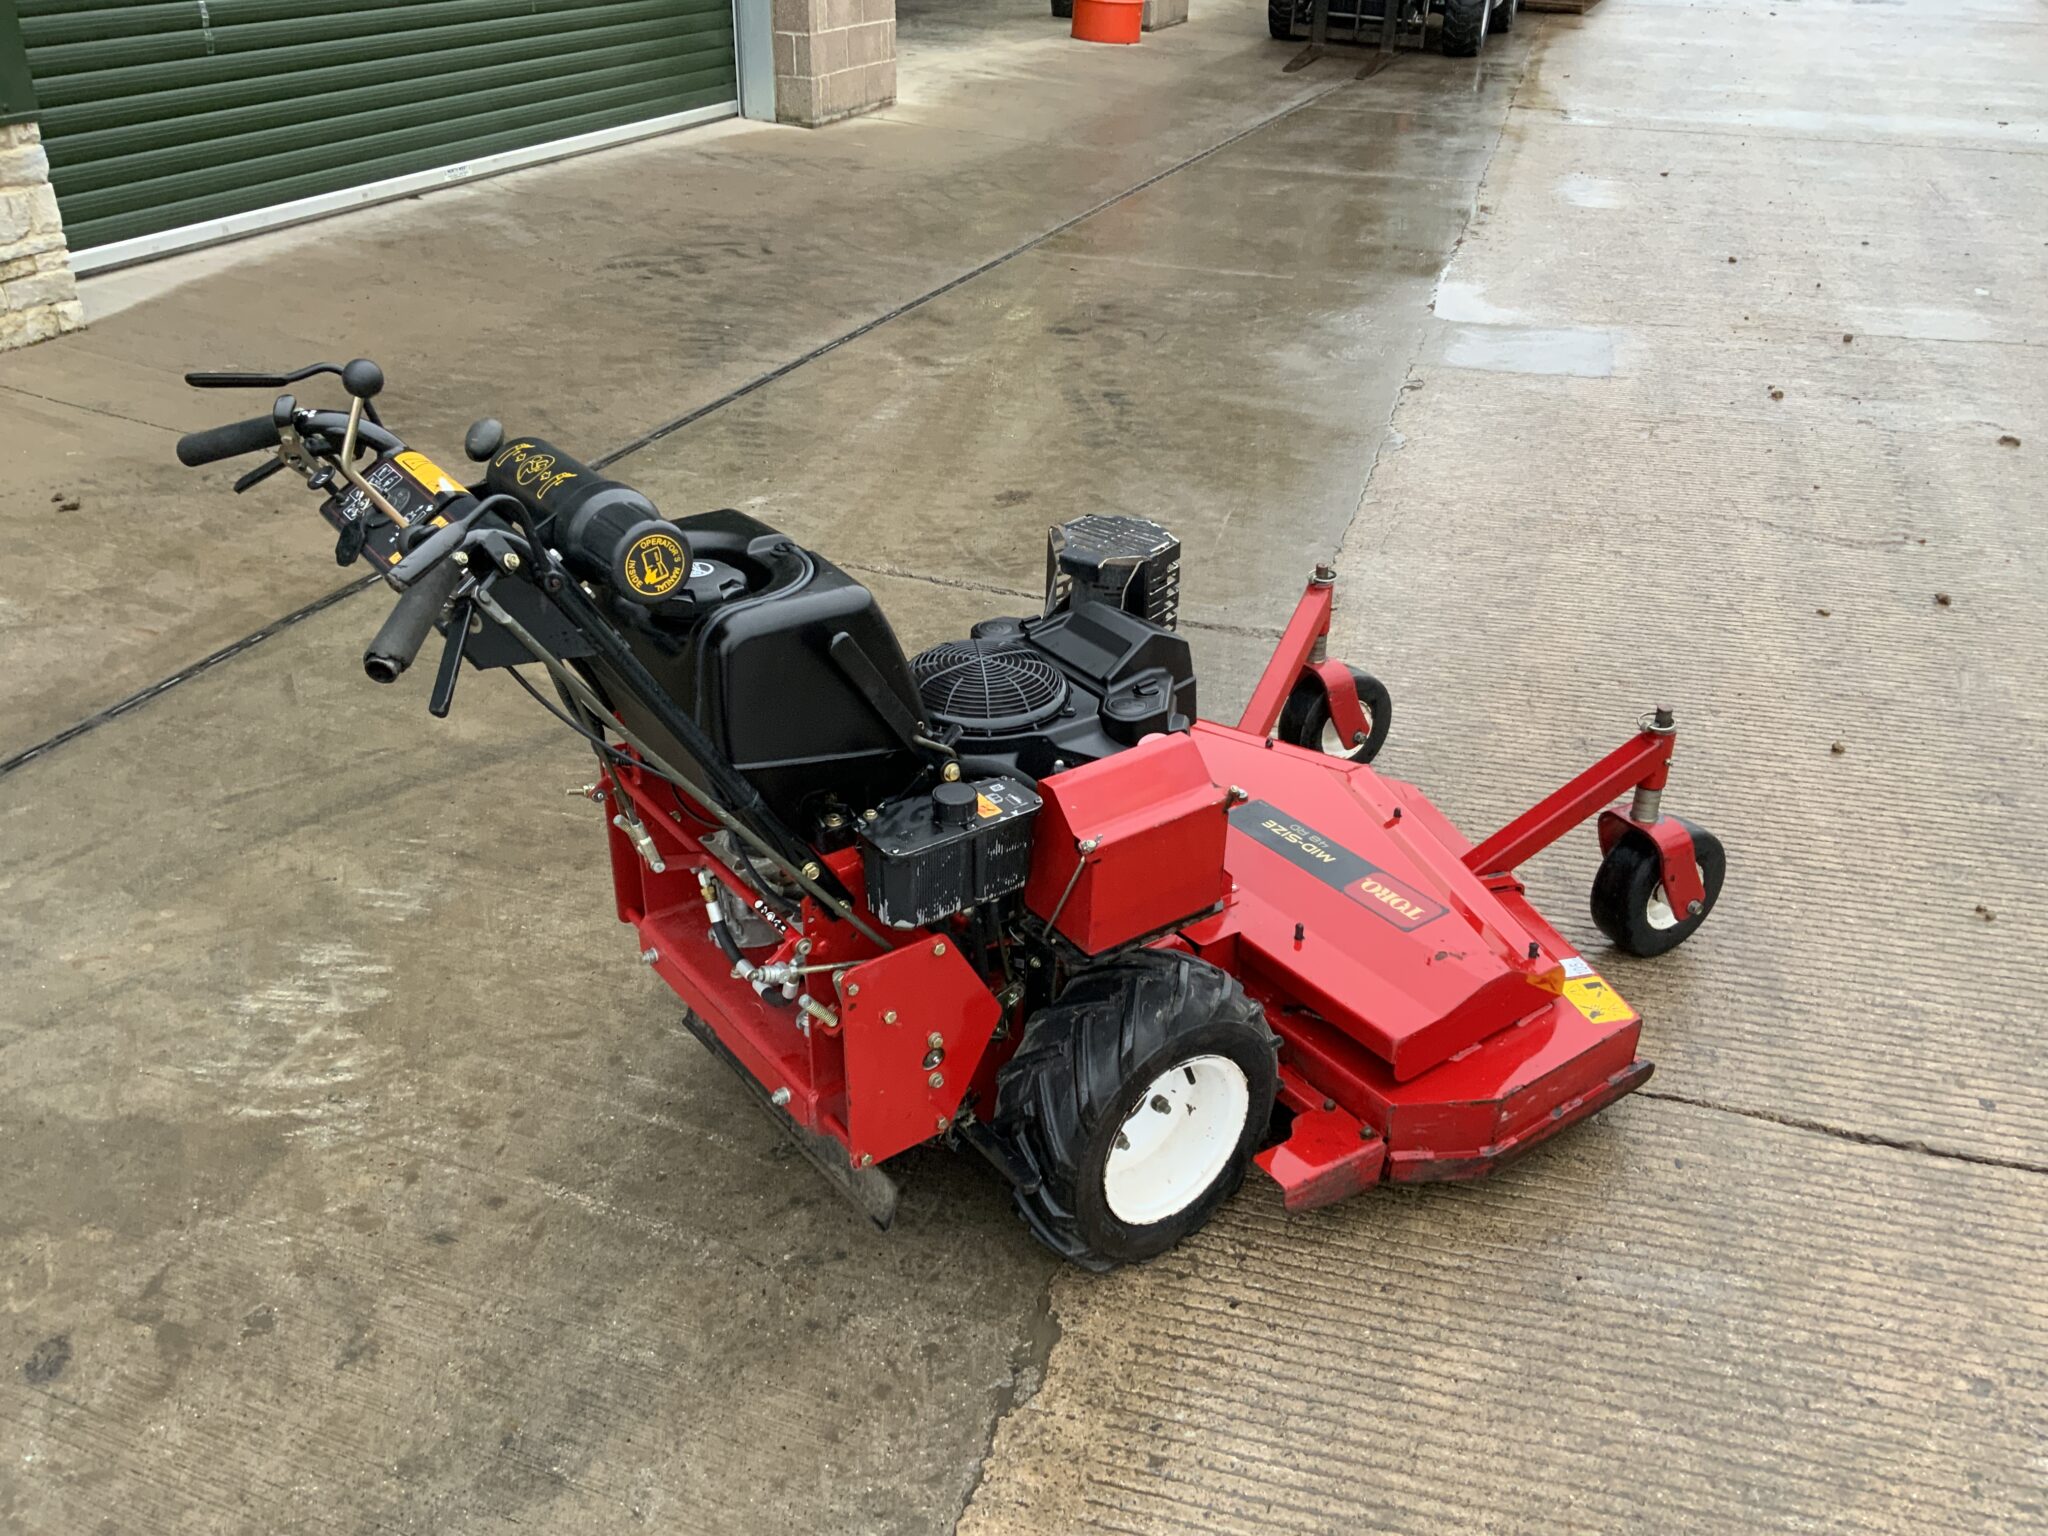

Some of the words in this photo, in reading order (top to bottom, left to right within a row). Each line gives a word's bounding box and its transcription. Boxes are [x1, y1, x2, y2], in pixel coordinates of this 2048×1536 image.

[640, 538, 681, 562] OPERATOR'S
[628, 560, 643, 588] INSIDE
[654, 567, 681, 591] MANUAL
[1261, 819, 1336, 863] MID-SIZE
[1308, 835, 1330, 849] 48
[1360, 877, 1426, 921] TORO
